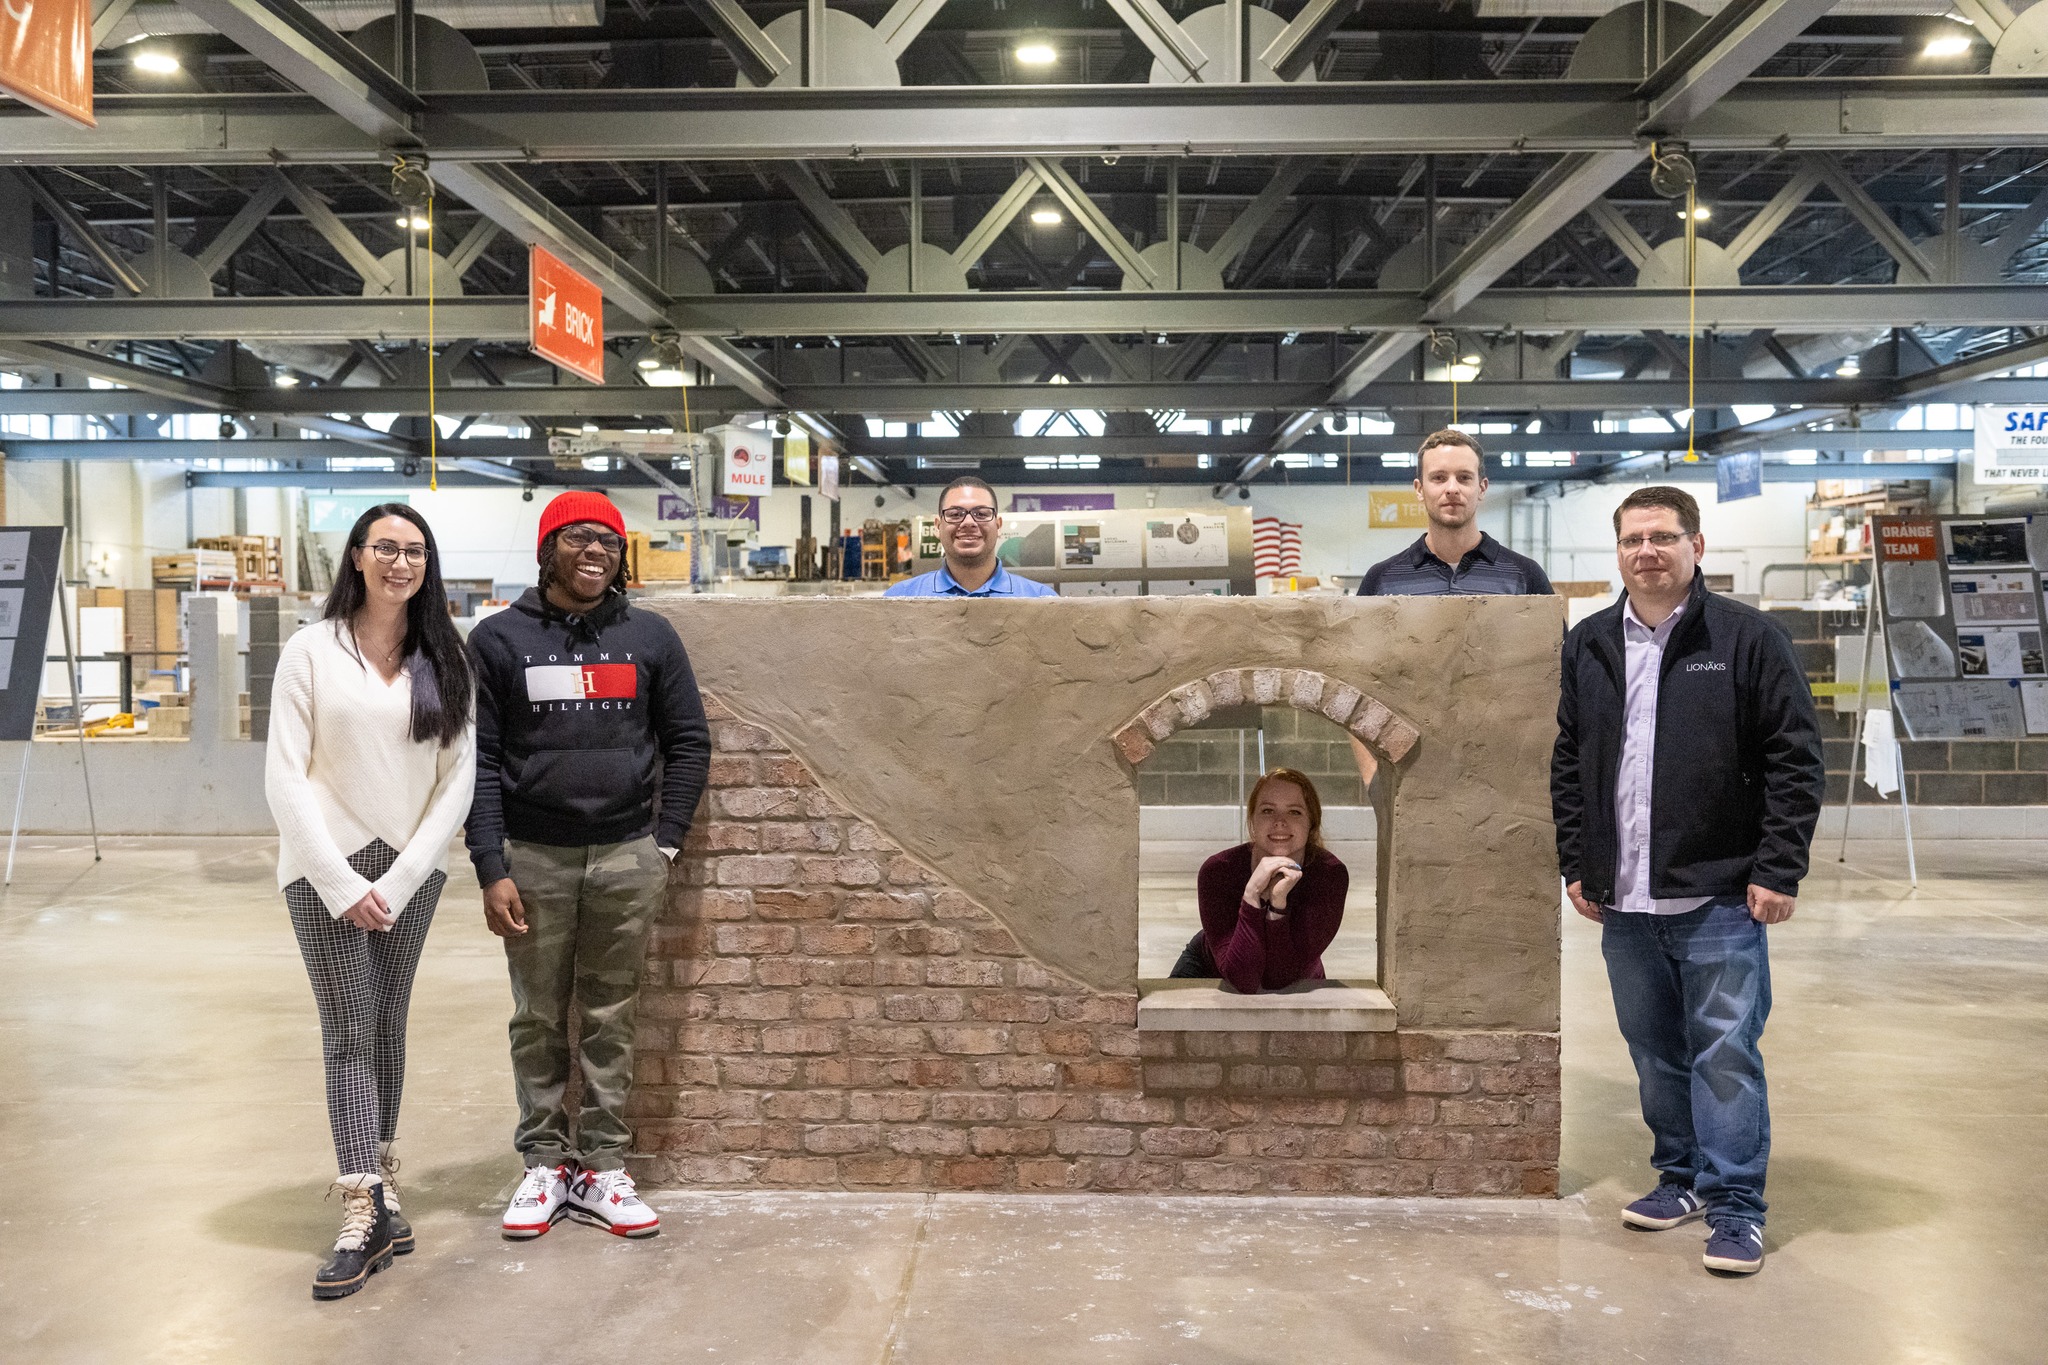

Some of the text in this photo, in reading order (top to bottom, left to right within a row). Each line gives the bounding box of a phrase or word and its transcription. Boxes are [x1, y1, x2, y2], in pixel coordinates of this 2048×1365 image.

[565, 302, 594, 347] BRICK
[2011, 436, 2027, 444] THE
[731, 473, 765, 485] MULE
[1984, 469, 2006, 478] THAT
[2010, 469, 2039, 477] NEVER
[1882, 526, 1934, 538] ORANGE
[1884, 543, 1919, 555] TEAM
[524, 653, 632, 663] TOMMY
[571, 671, 597, 693] H
[532, 702, 631, 712] HILFIGER
